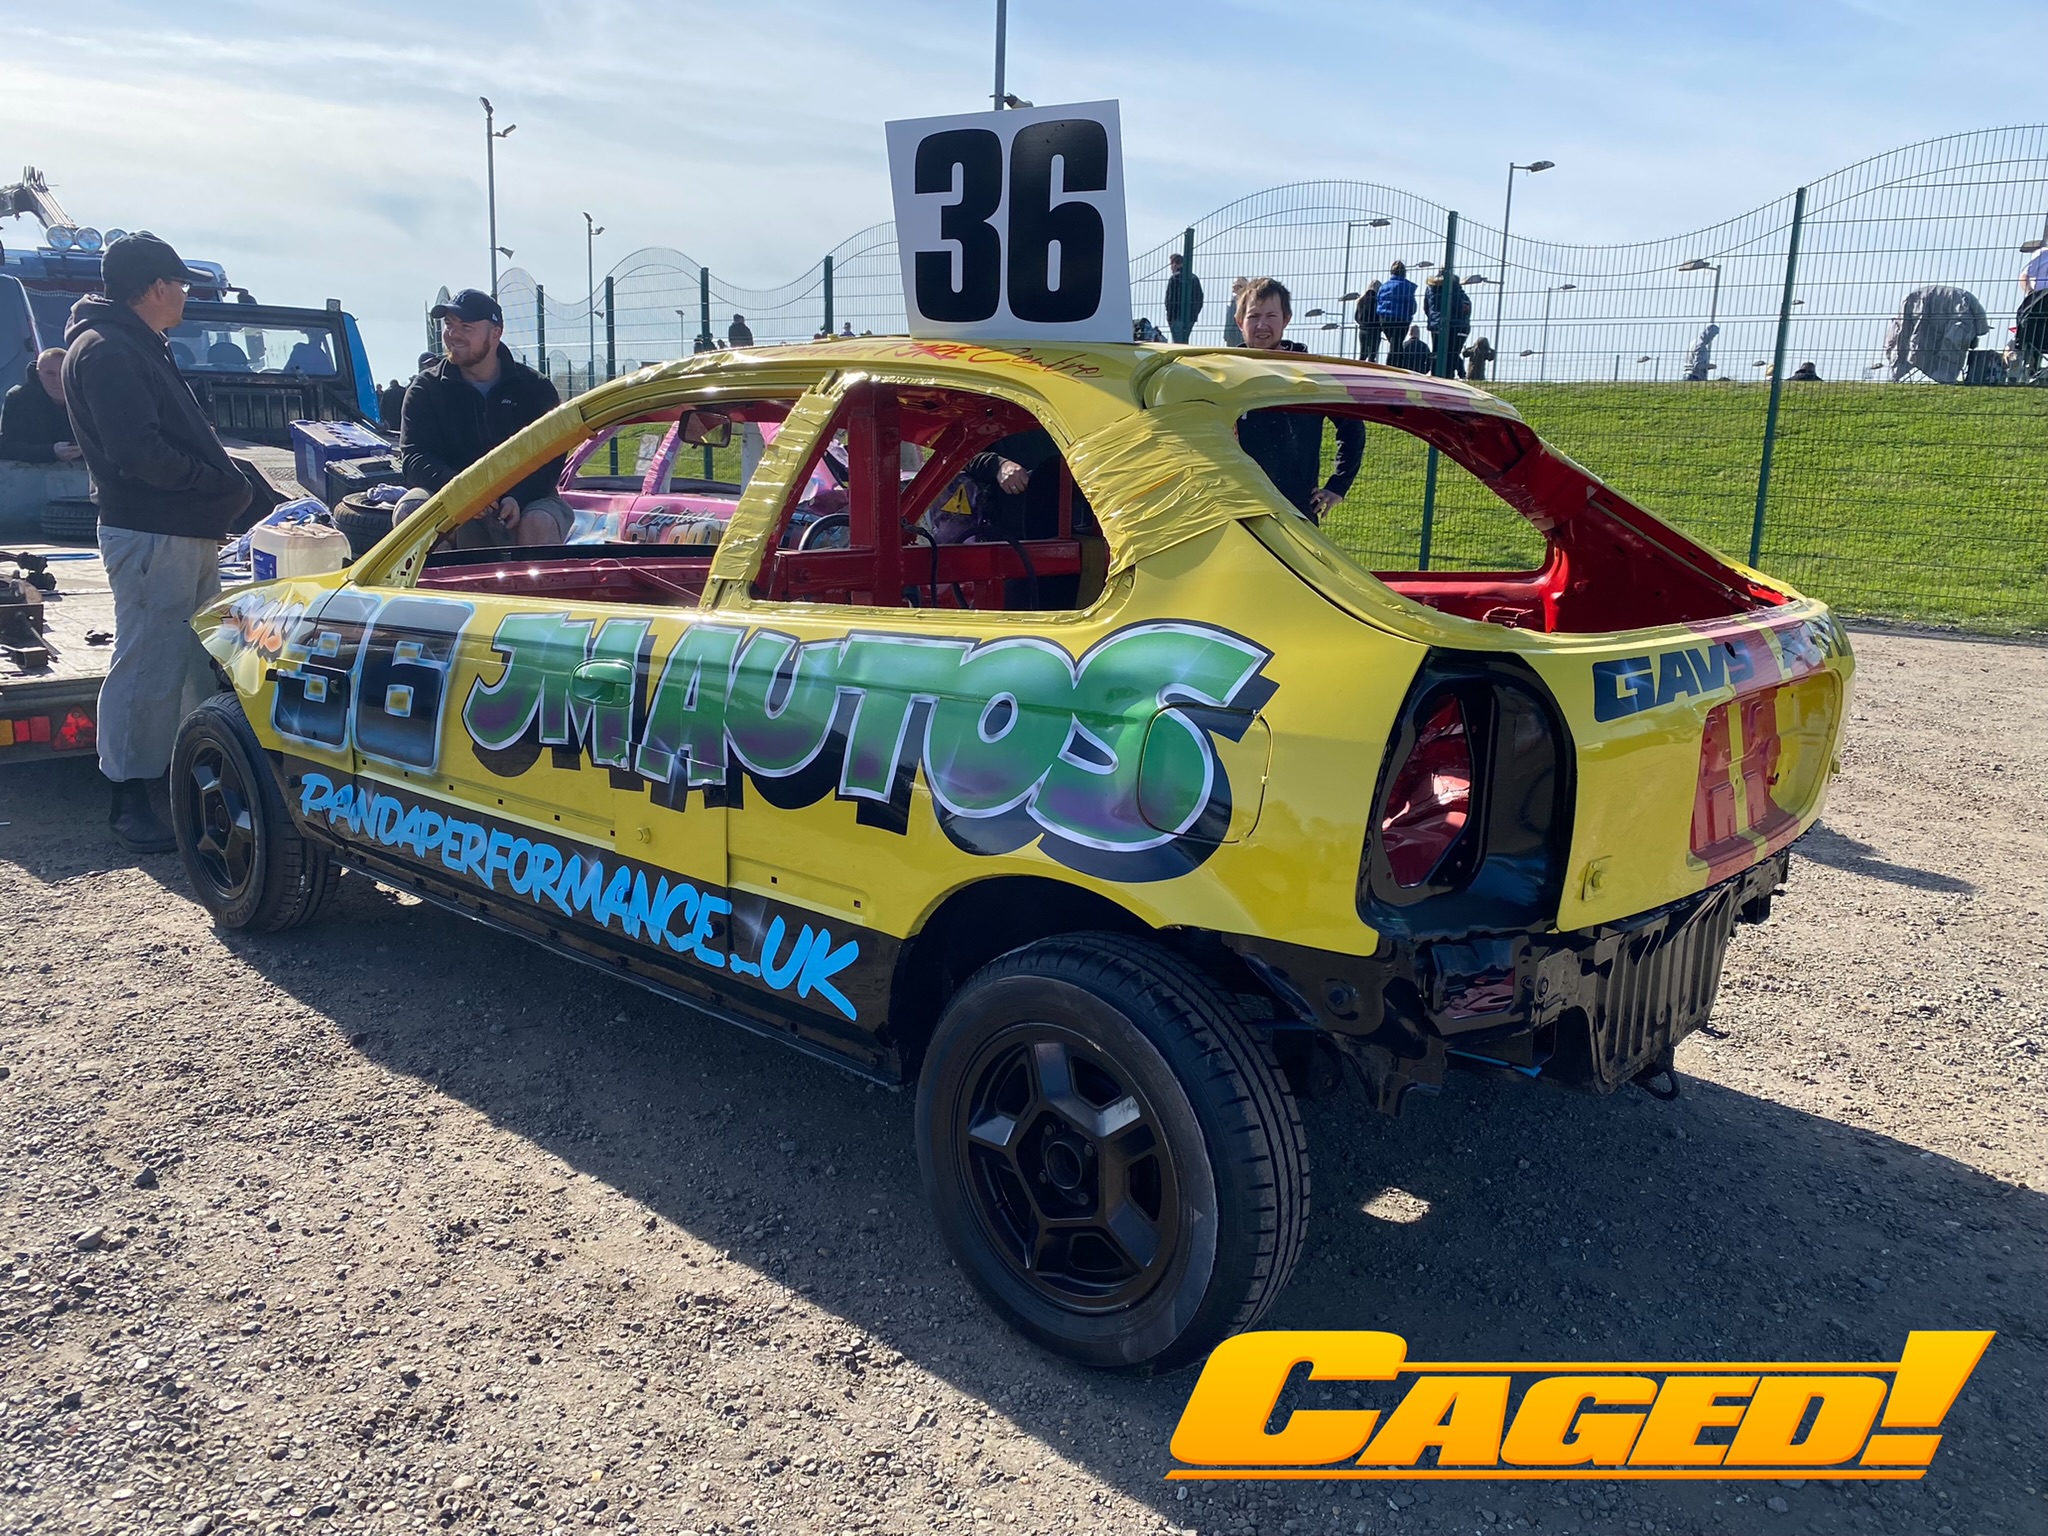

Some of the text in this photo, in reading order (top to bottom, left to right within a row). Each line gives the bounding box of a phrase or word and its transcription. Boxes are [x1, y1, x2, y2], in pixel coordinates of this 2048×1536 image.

[914, 118, 1109, 323] 36
[270, 590, 475, 776] 36
[1592, 639, 1755, 723] GAVS
